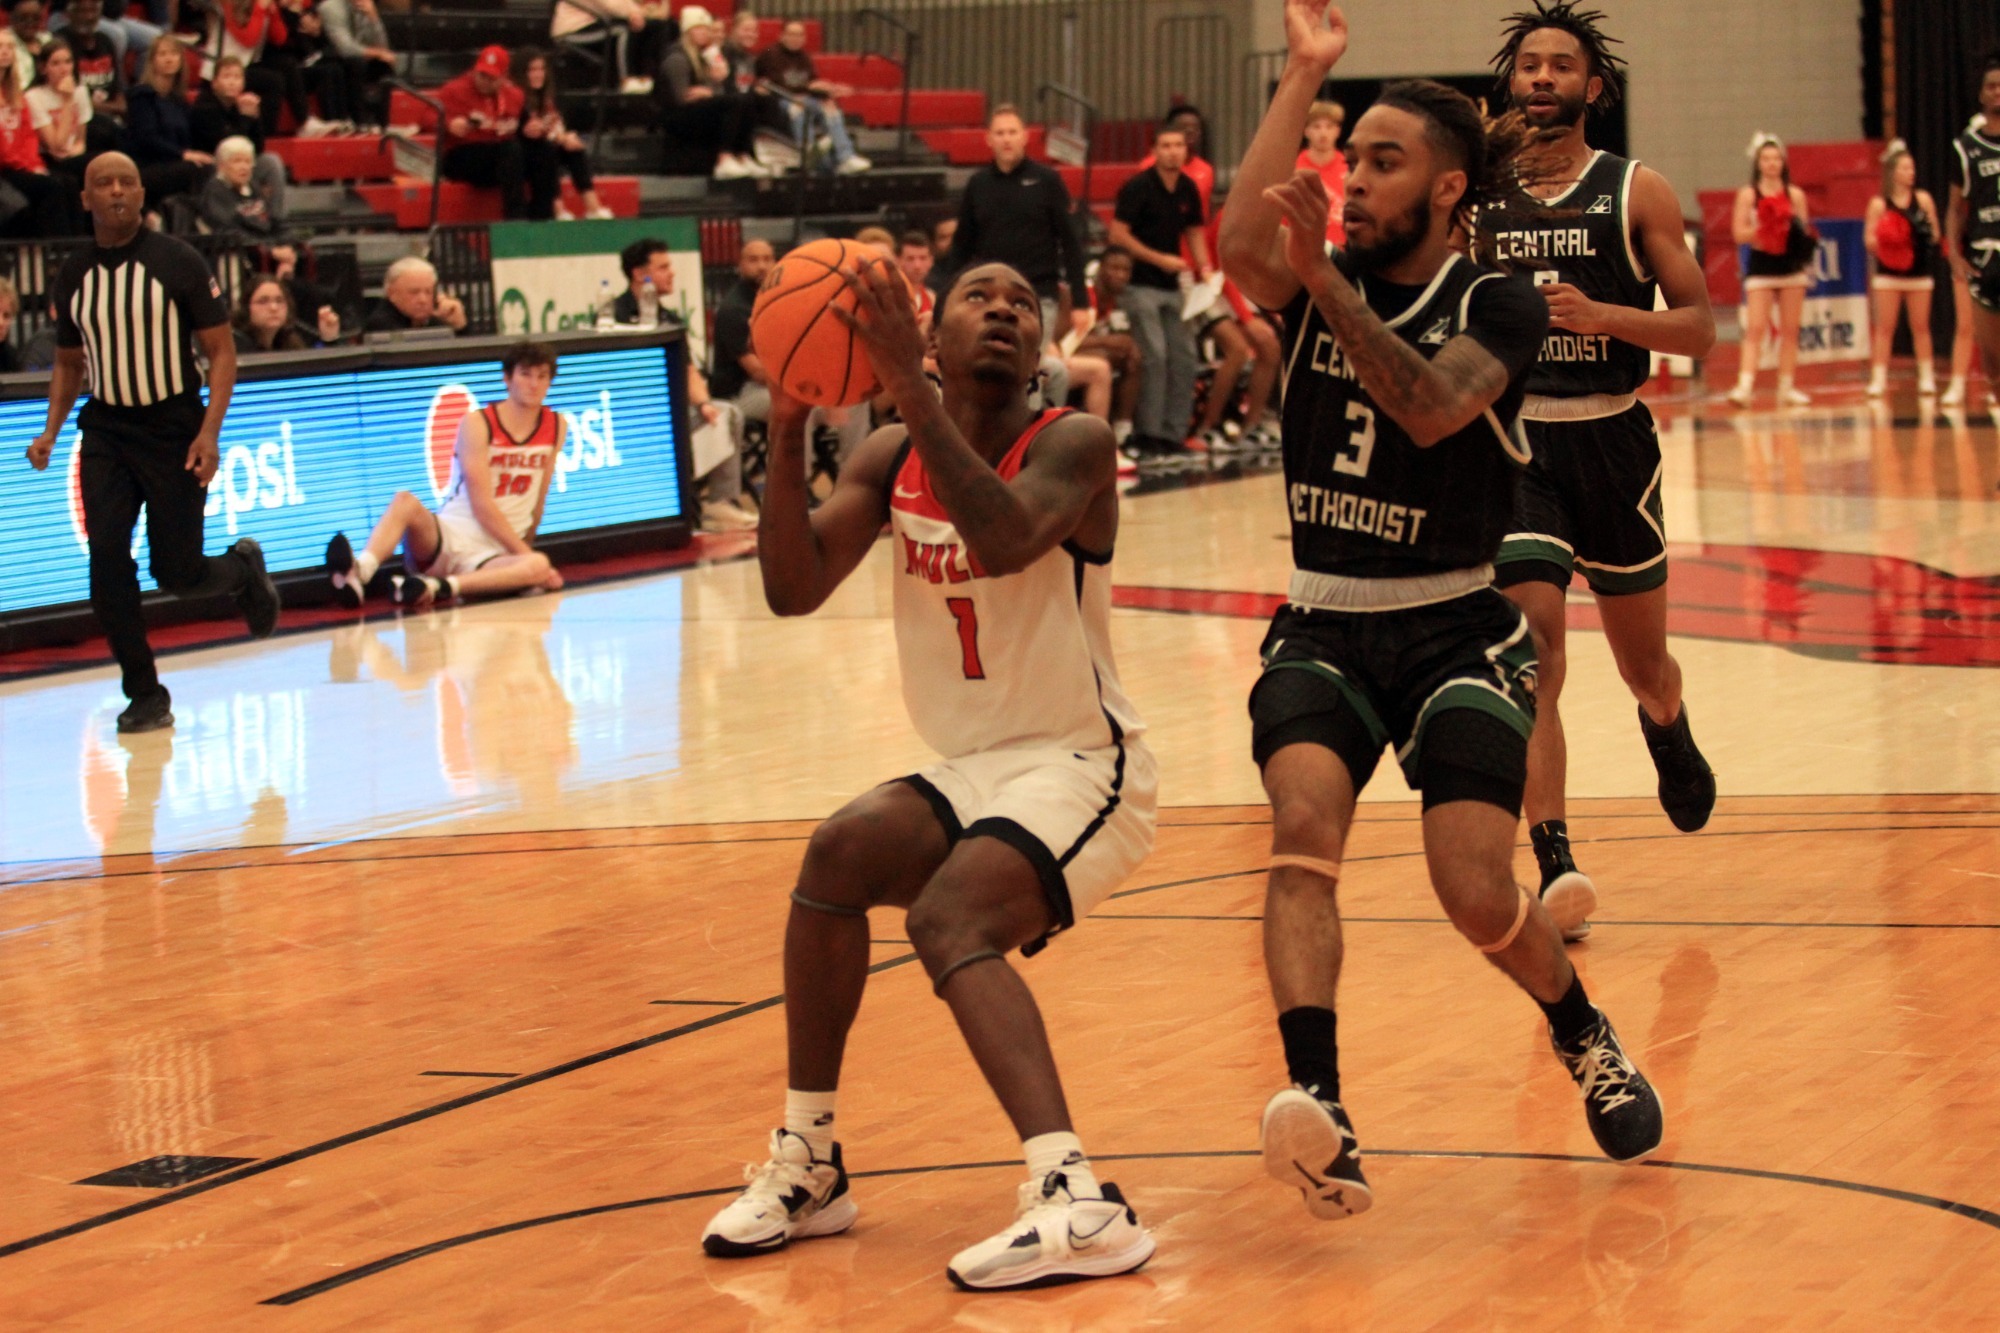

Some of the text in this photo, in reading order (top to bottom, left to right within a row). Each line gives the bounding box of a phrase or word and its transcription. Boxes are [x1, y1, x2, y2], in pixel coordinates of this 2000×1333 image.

[1496, 228, 1596, 260] CENTRAL
[1537, 335, 1610, 362] HODIST
[556, 390, 622, 493] psi
[1333, 400, 1376, 478] 3
[901, 532, 988, 584] MUL
[945, 597, 986, 680] 1
